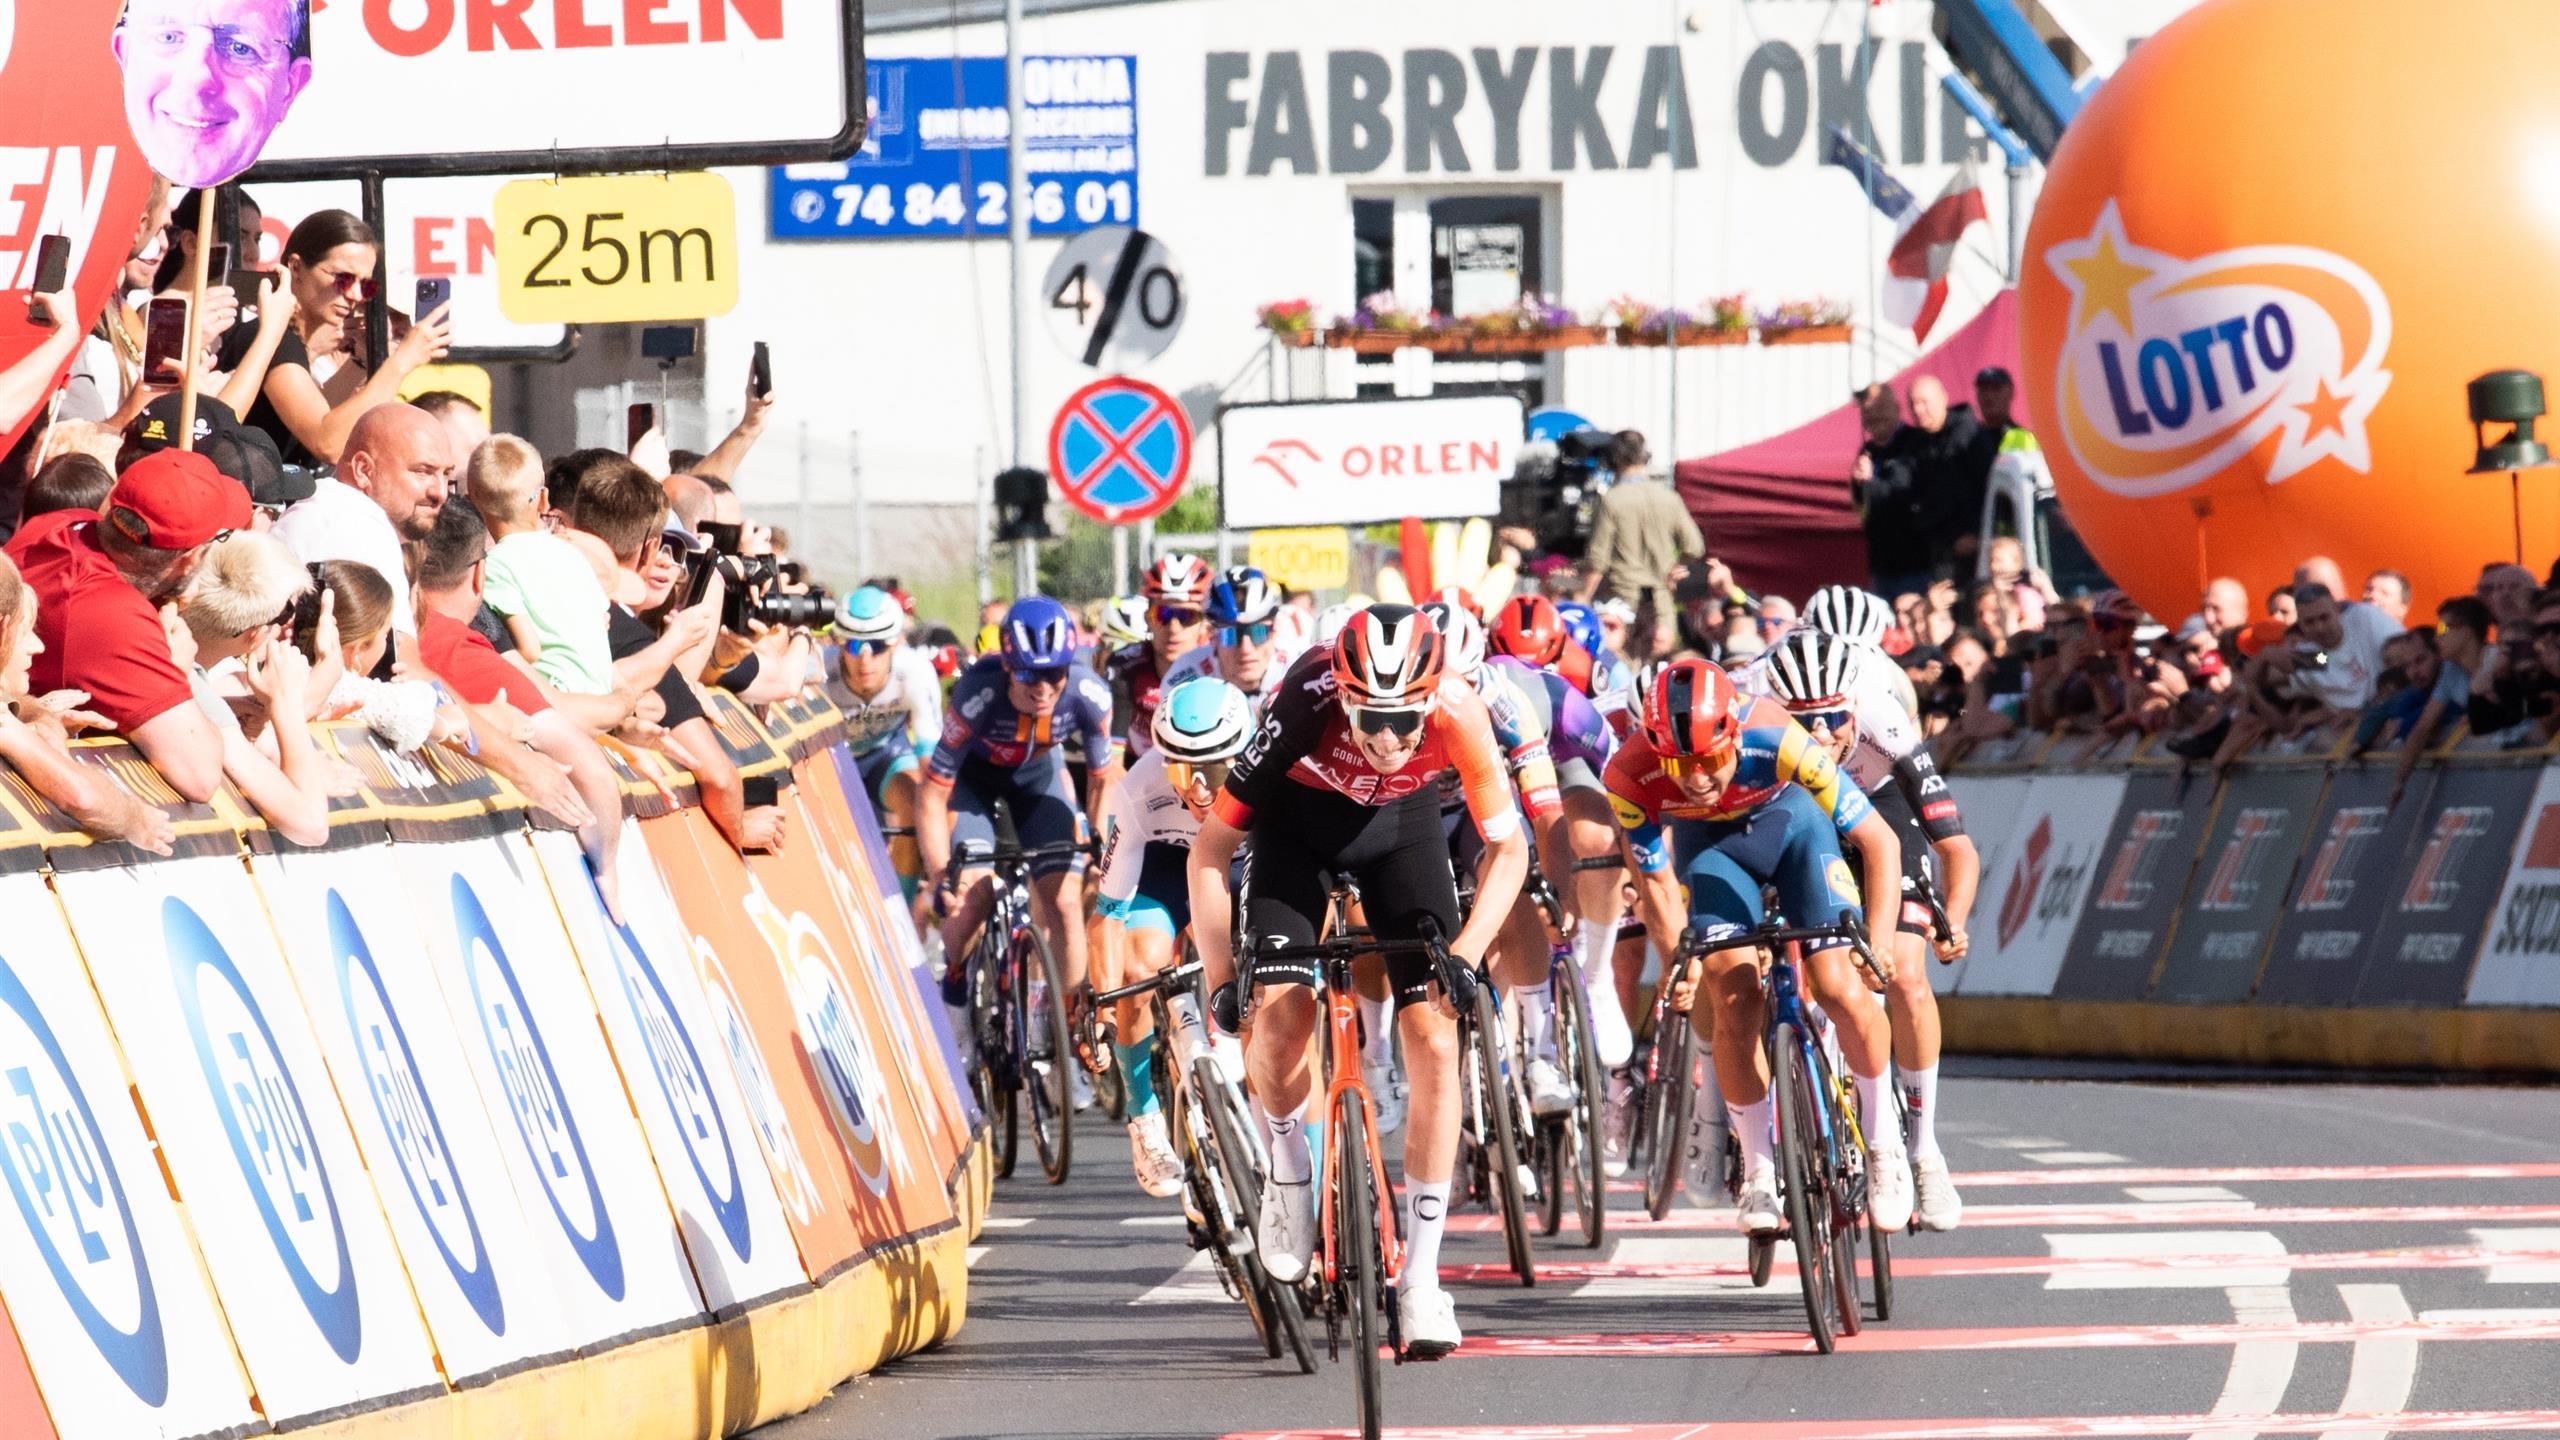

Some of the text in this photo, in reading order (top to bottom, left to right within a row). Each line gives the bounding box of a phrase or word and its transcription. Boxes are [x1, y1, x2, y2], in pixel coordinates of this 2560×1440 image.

[1021, 58, 1133, 105] OKNA
[1203, 44, 1700, 177] FABRYKA
[831, 184, 895, 226] 74
[903, 182, 967, 226] 84
[1075, 180, 1132, 223] 01
[522, 212, 715, 289] 25m
[2097, 302, 2295, 437] LOTTO
[1341, 440, 1500, 479] ORLEN
[1232, 712, 1283, 783] INEOS
[1332, 747, 1365, 768] GOBIK
[1100, 823, 1122, 884] MERIDA
